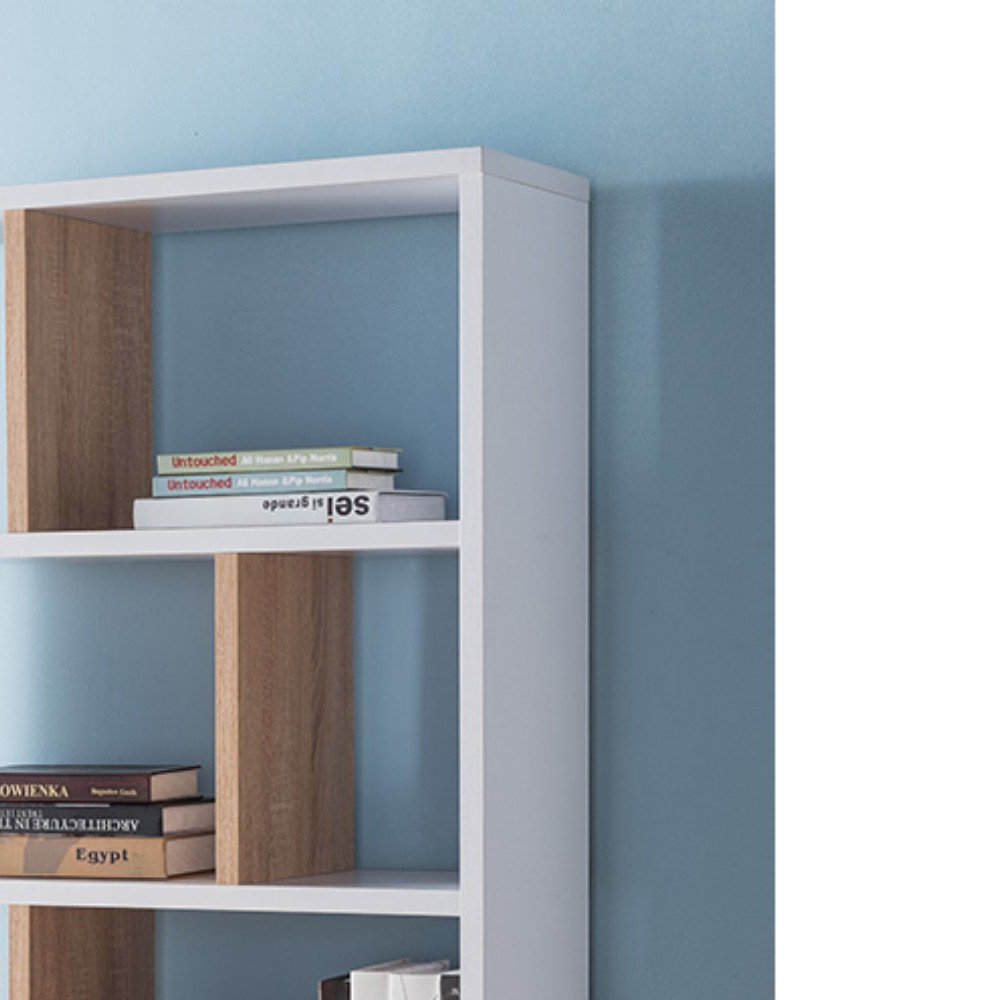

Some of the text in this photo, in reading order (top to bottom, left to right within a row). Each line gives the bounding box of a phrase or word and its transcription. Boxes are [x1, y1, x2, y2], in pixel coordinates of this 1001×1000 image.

[171, 453, 237, 468] Untouched
[167, 477, 232, 491] Untouched
[262, 495, 370, 523] sei si grande
[14, 817, 30, 830] IN
[32, 817, 140, 832] ARCHITECYURE
[76, 847, 129, 865] Egypt
